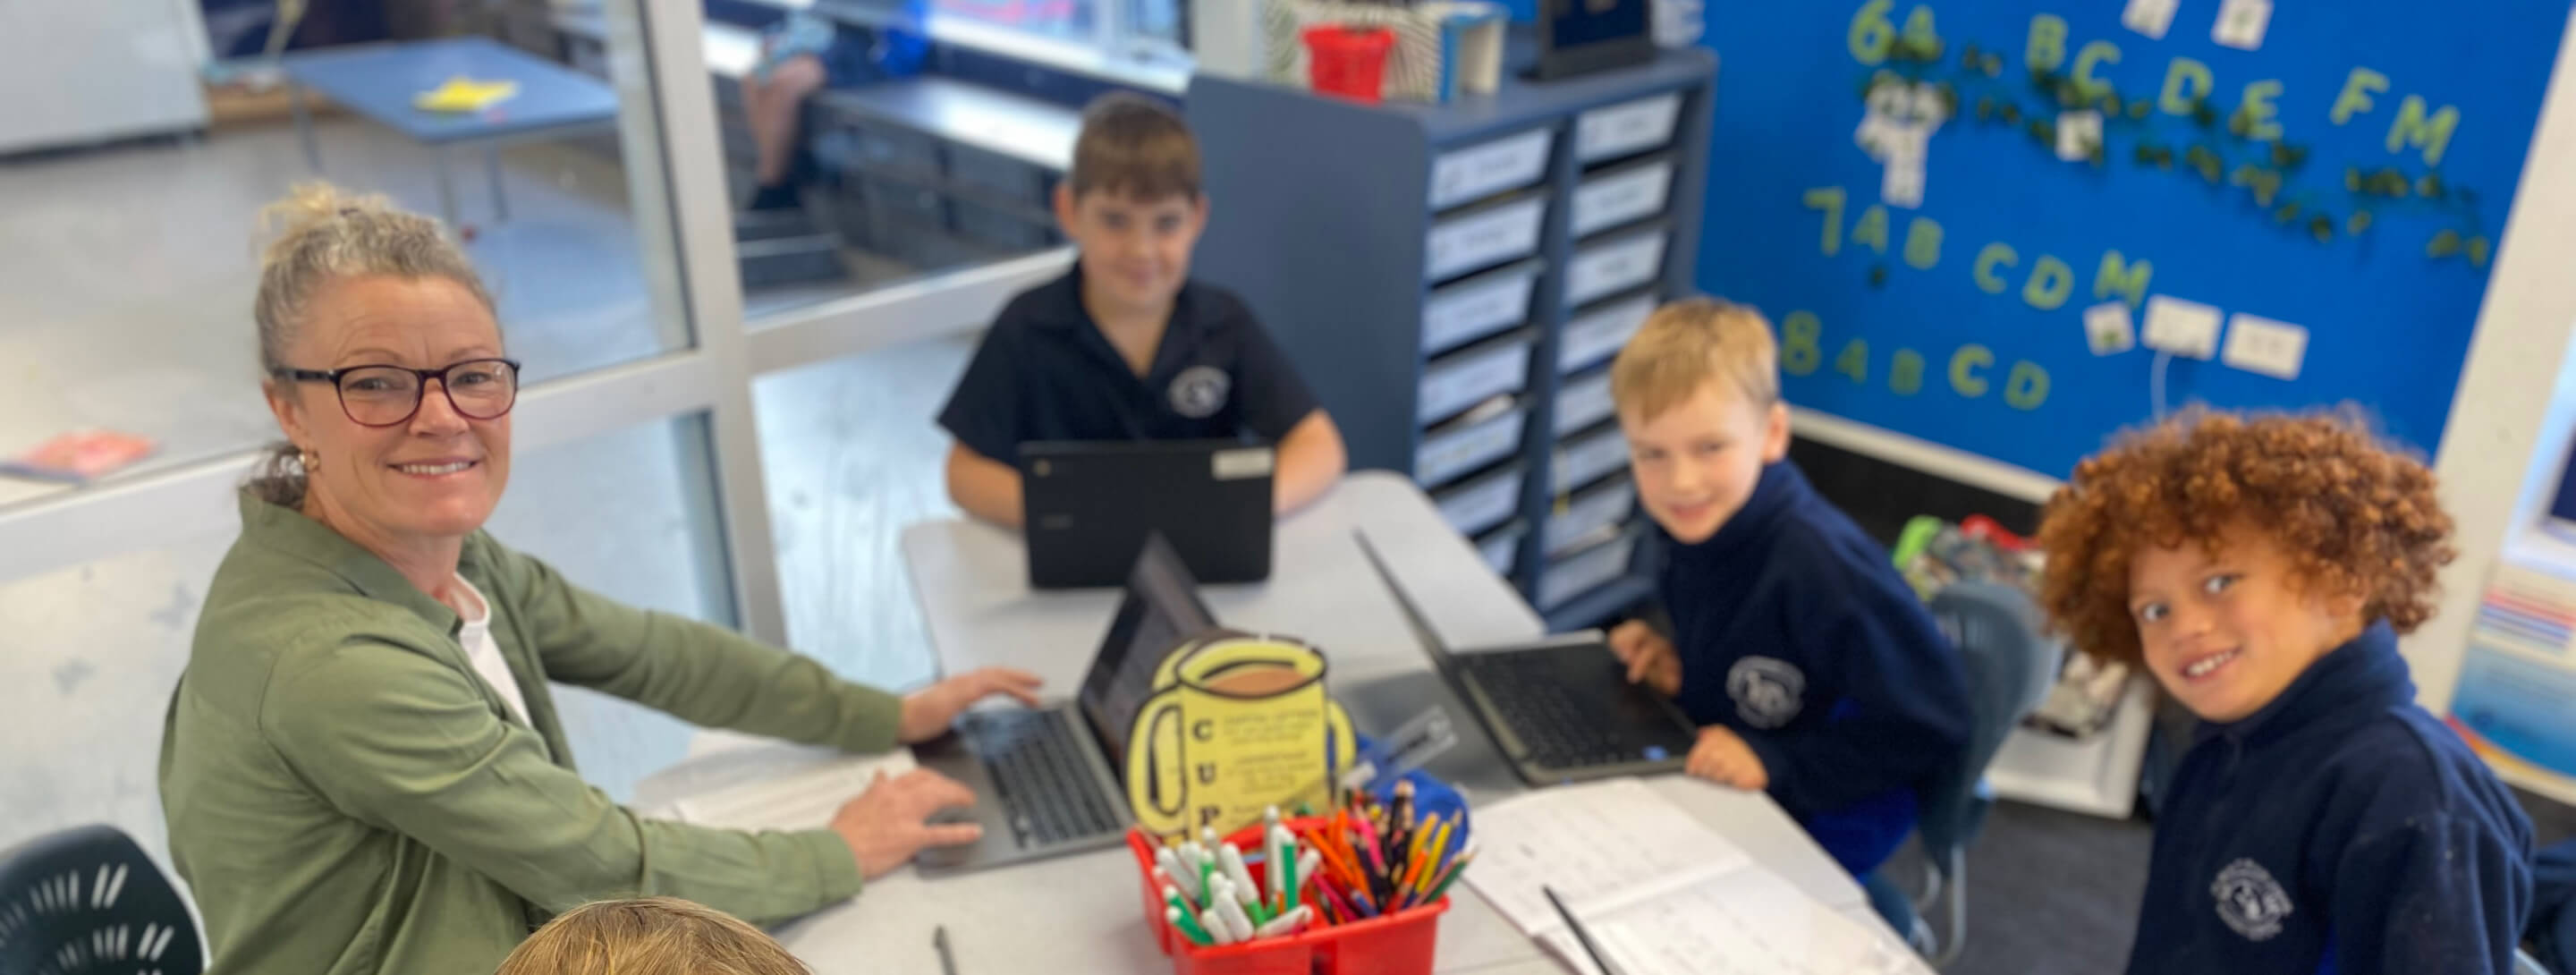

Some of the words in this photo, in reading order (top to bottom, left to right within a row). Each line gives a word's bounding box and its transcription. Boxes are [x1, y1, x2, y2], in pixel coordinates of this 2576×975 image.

[2025, 13, 2068, 75] B
[2071, 40, 2122, 101] C
[2158, 56, 2213, 115] D
[2241, 79, 2284, 140] E
[2330, 66, 2390, 125] F
[2385, 94, 2460, 167] M
[1972, 242, 2019, 294] C
[2021, 254, 2075, 310] D
[2093, 250, 2154, 309] M
[1948, 343, 1996, 398] C
[2004, 360, 2052, 411] D
